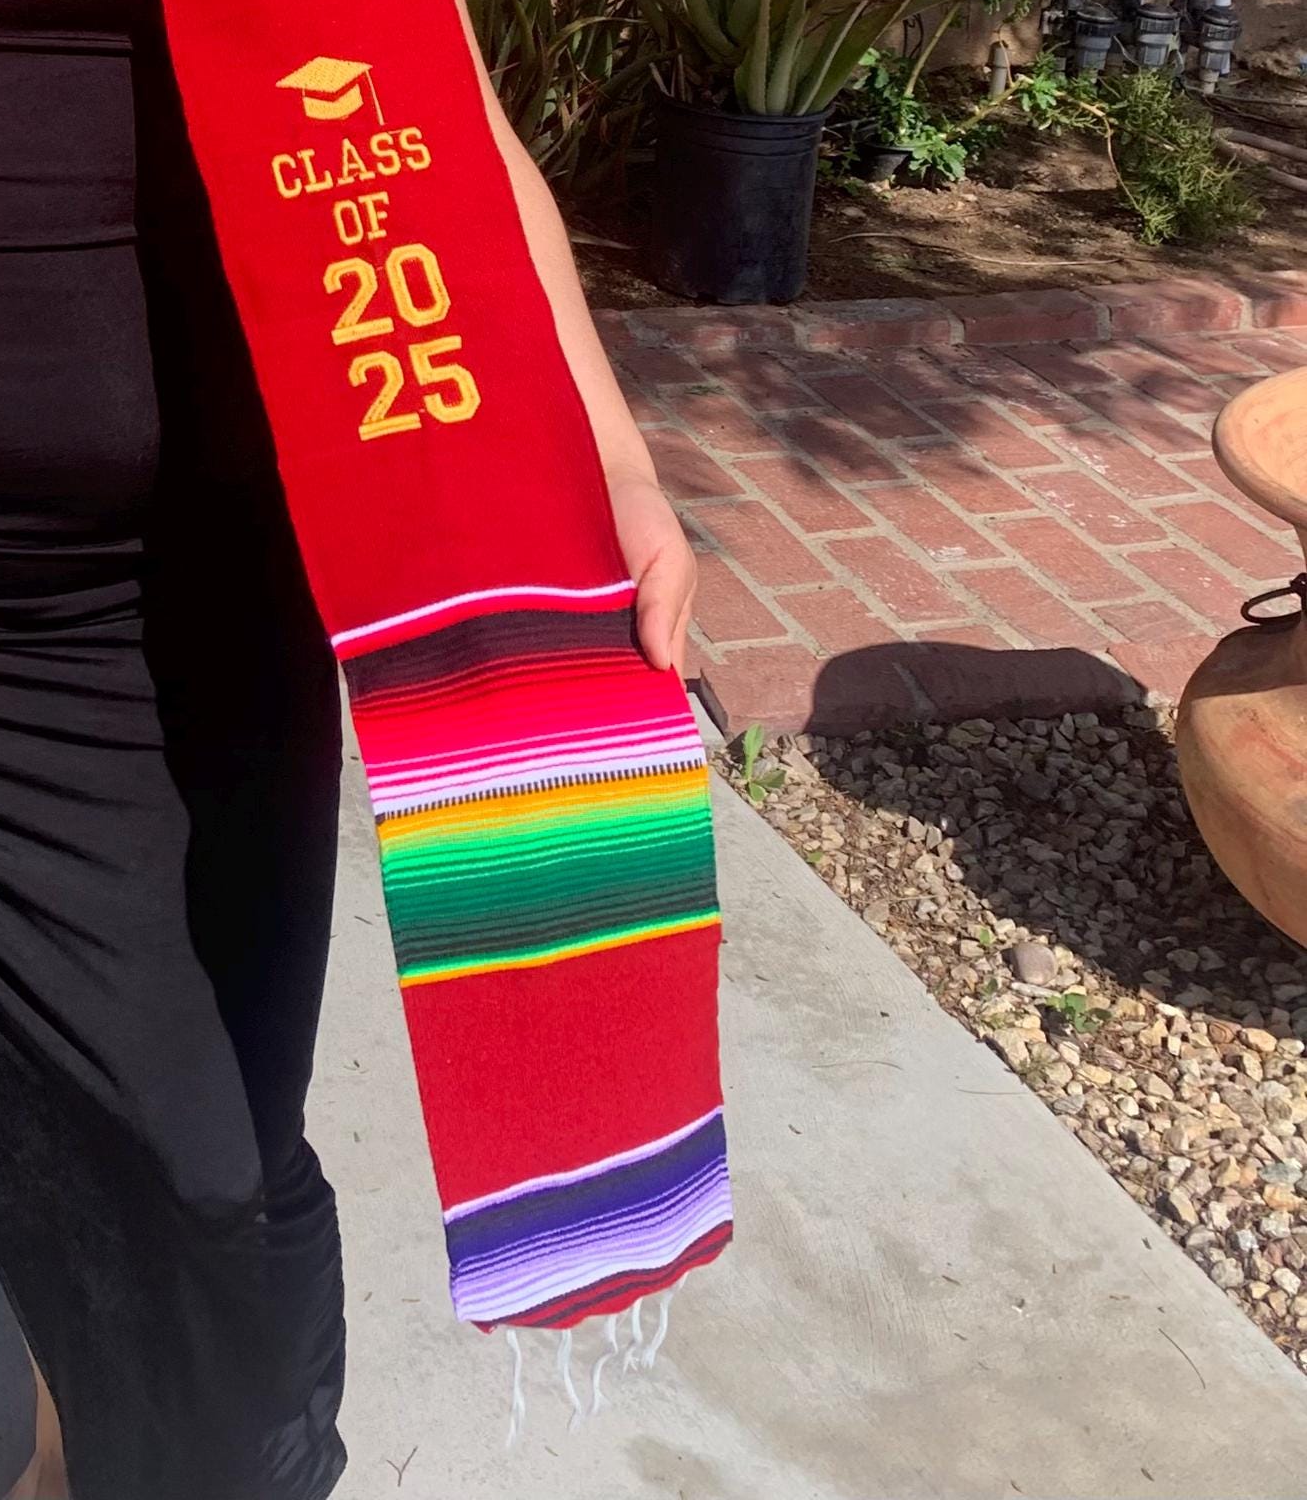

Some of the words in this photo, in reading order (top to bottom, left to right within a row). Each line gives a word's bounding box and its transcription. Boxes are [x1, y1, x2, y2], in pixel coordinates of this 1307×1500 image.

[271, 127, 432, 199] CLASS
[333, 191, 390, 246] OF
[322, 243, 451, 346] 20
[348, 335, 481, 441] 25
